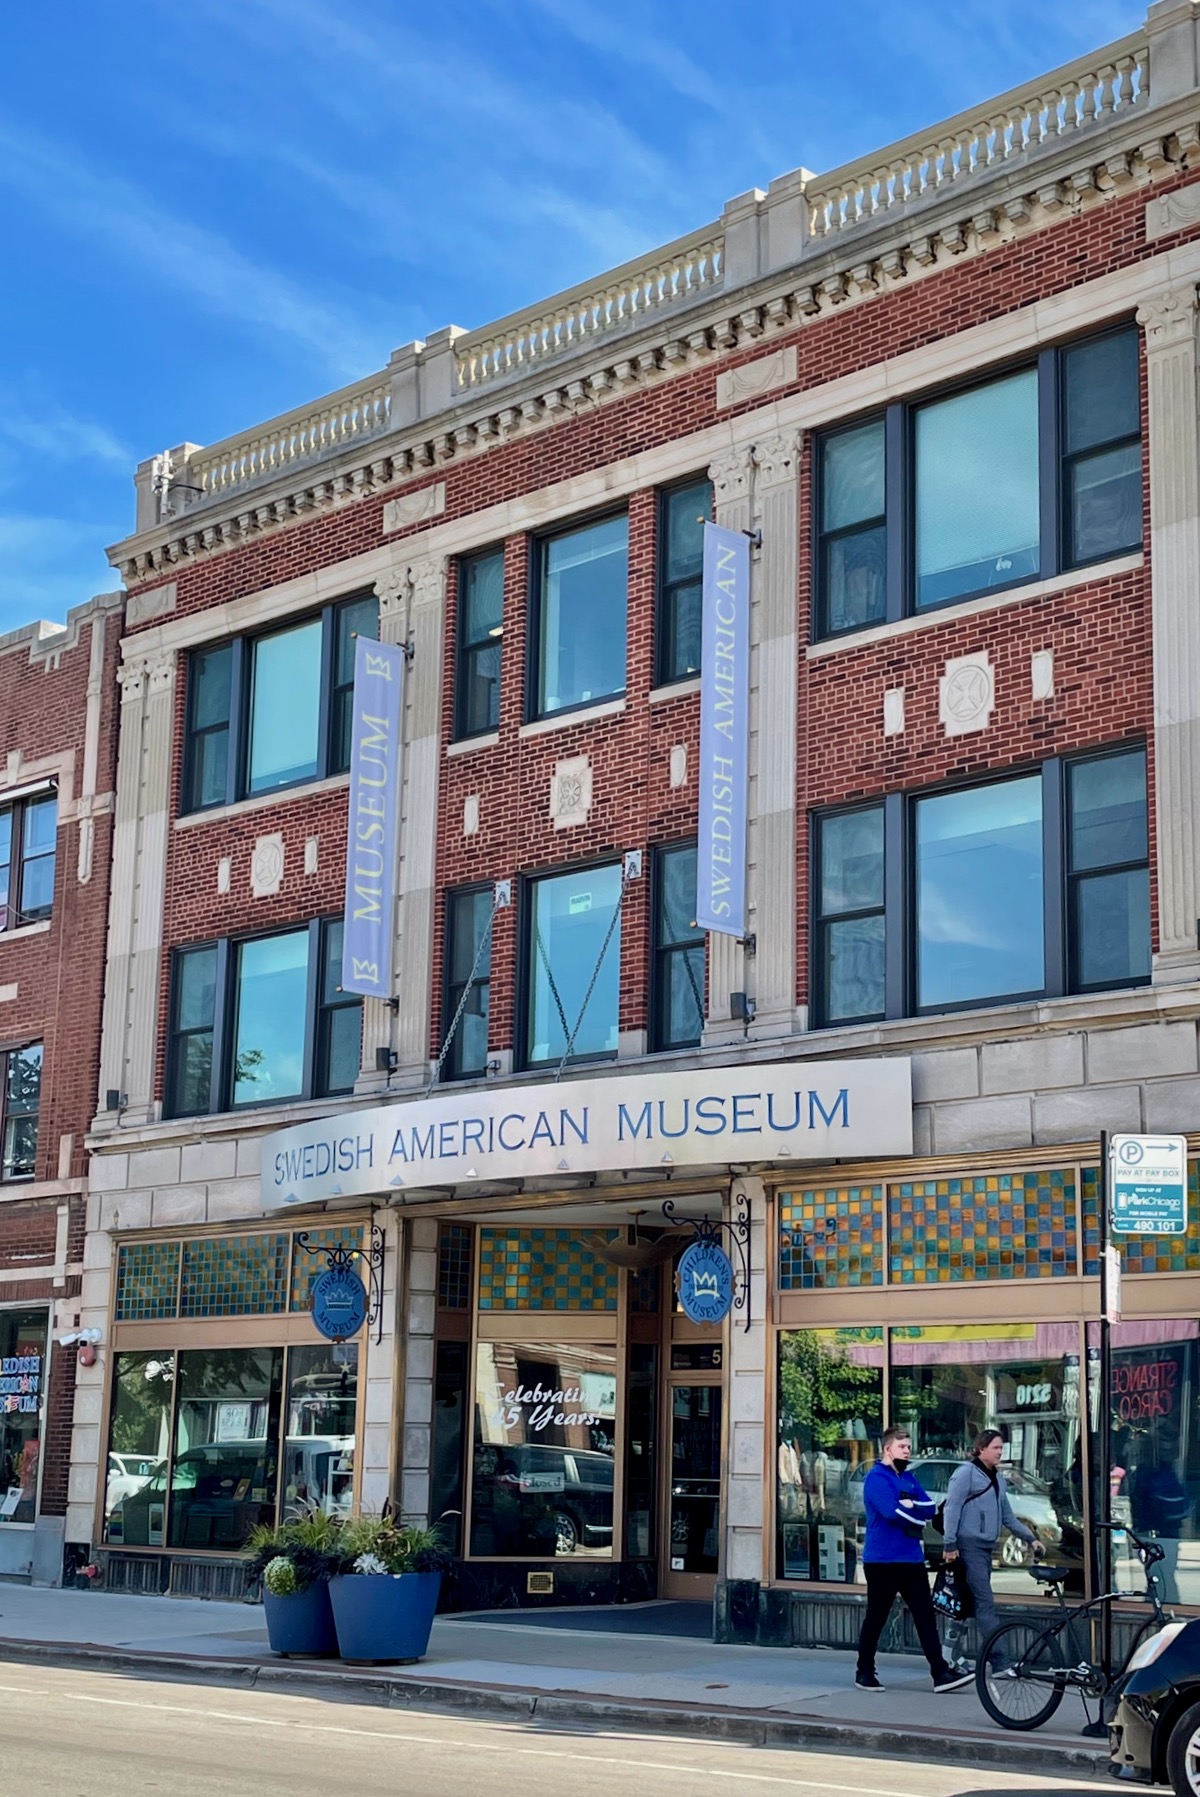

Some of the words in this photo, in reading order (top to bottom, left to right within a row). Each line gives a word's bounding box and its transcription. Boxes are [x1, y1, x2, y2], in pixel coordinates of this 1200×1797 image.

[713, 543, 738, 741] AMERICAN
[353, 711, 390, 926] MUSEUM
[711, 755, 734, 918] SWEDISH
[274, 1133, 374, 1186] SWEDISH
[388, 1107, 590, 1165] AMERICAN
[618, 1088, 850, 1141] MUSEUM
[1126, 1145, 1138, 1160] P
[1133, 1220, 1154, 1231] 490
[1156, 1221, 1176, 1231] 101
[683, 1248, 730, 1286] CHILDREN'S
[318, 1272, 361, 1297] SWEDISH
[684, 1291, 729, 1319] MUSEUM
[317, 1311, 361, 1334] MUSEUM
[0, 1355, 40, 1374] EDISH
[711, 1349, 721, 1364] 5
